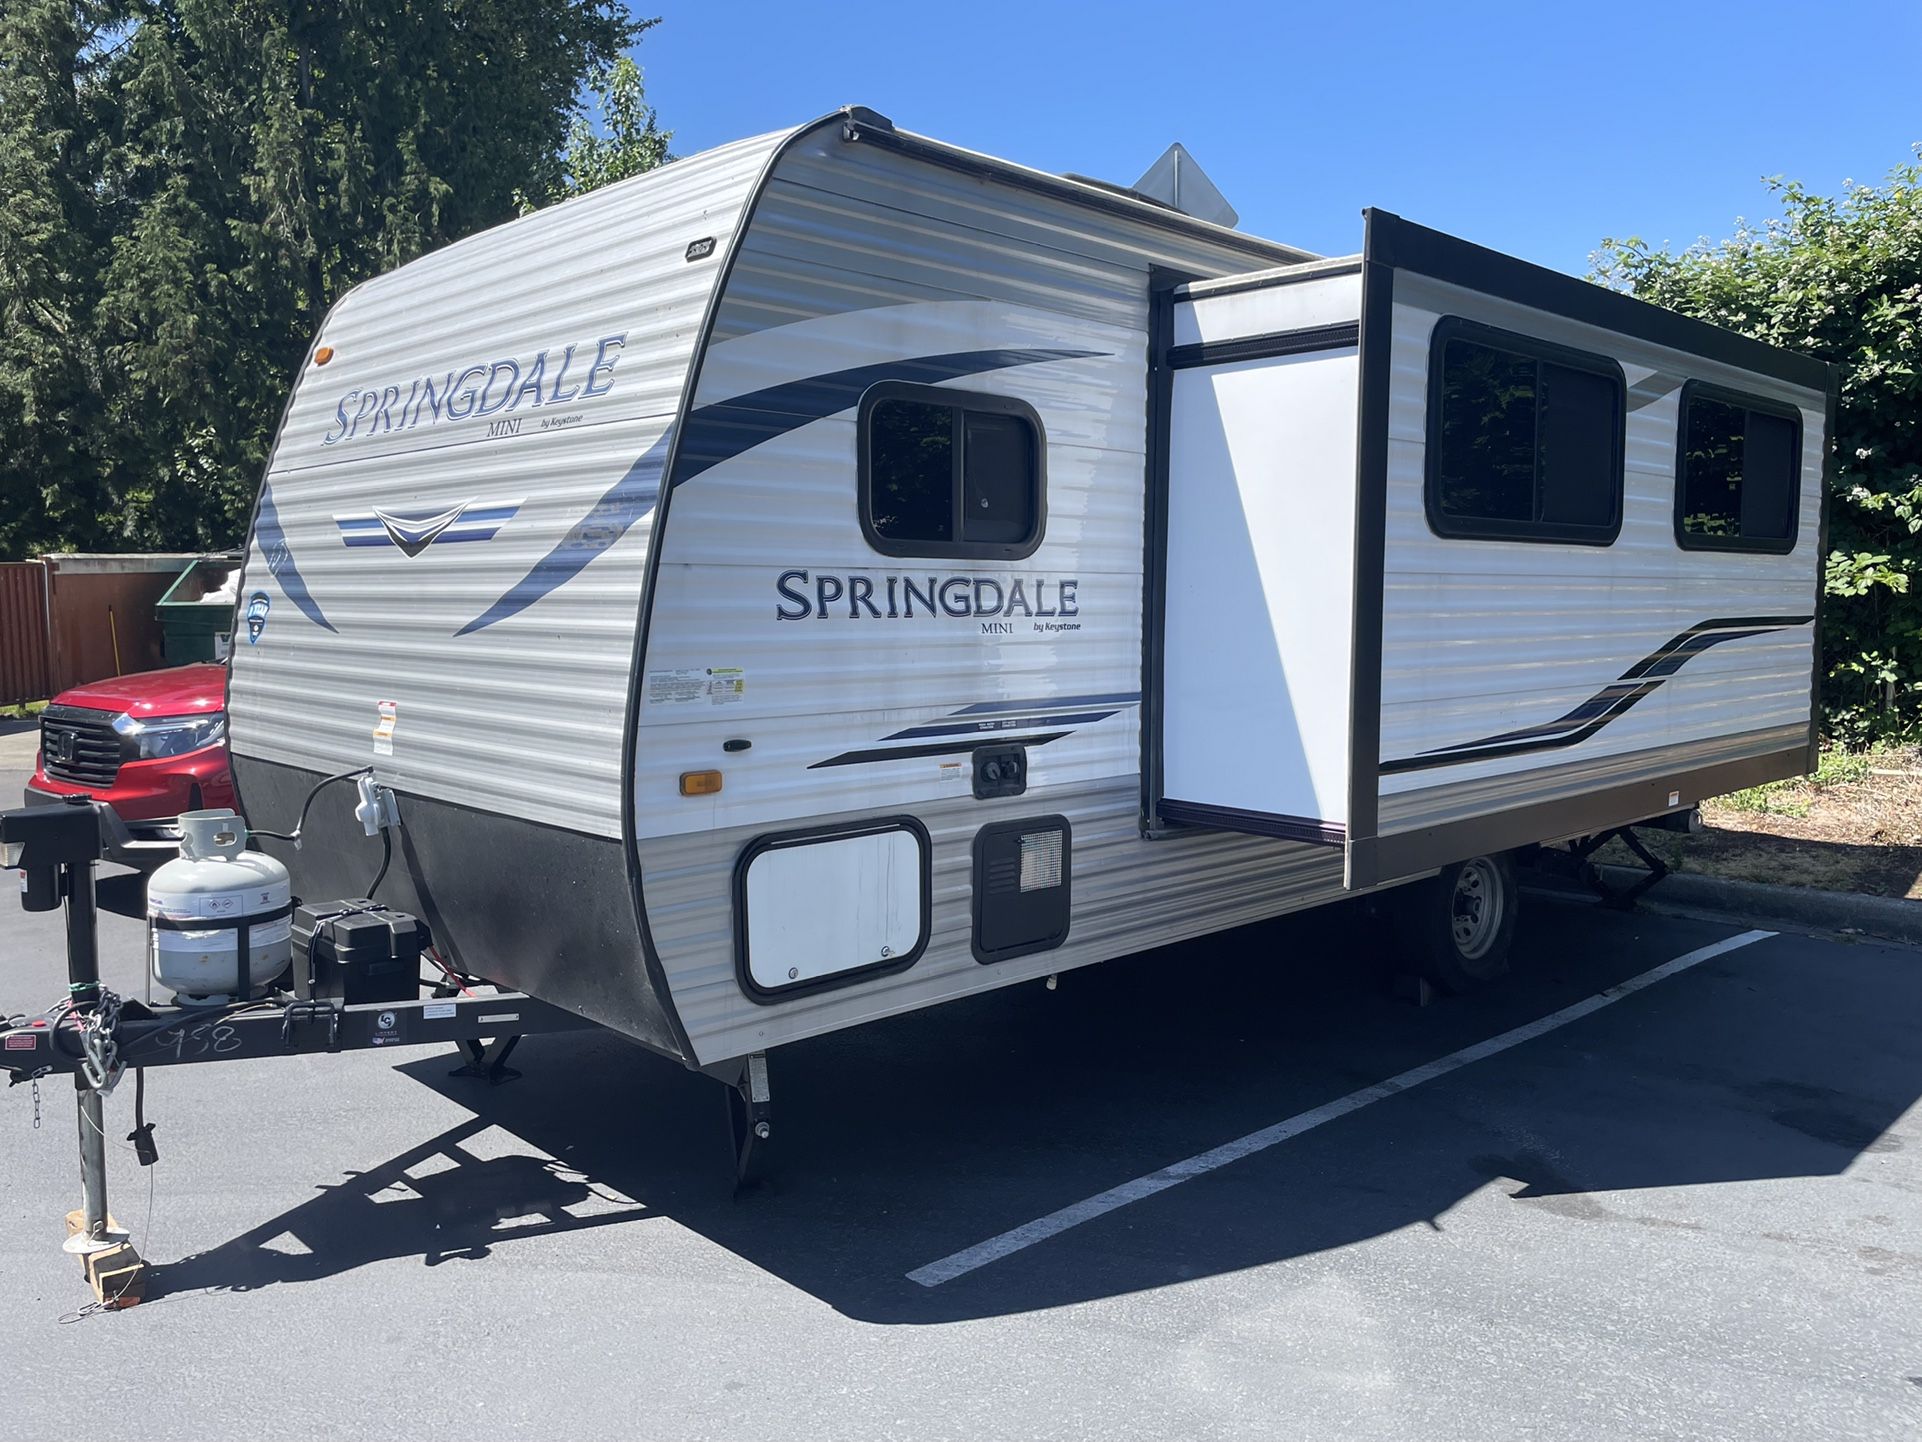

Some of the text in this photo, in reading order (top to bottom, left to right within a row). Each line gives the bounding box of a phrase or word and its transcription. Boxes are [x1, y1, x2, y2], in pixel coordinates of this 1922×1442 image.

[322, 331, 628, 446] SPRINGDALE
[487, 415, 583, 437] MINI by Keystone
[776, 569, 1080, 621] SPRINGDALE
[981, 621, 1081, 634] MINI by Keystone
